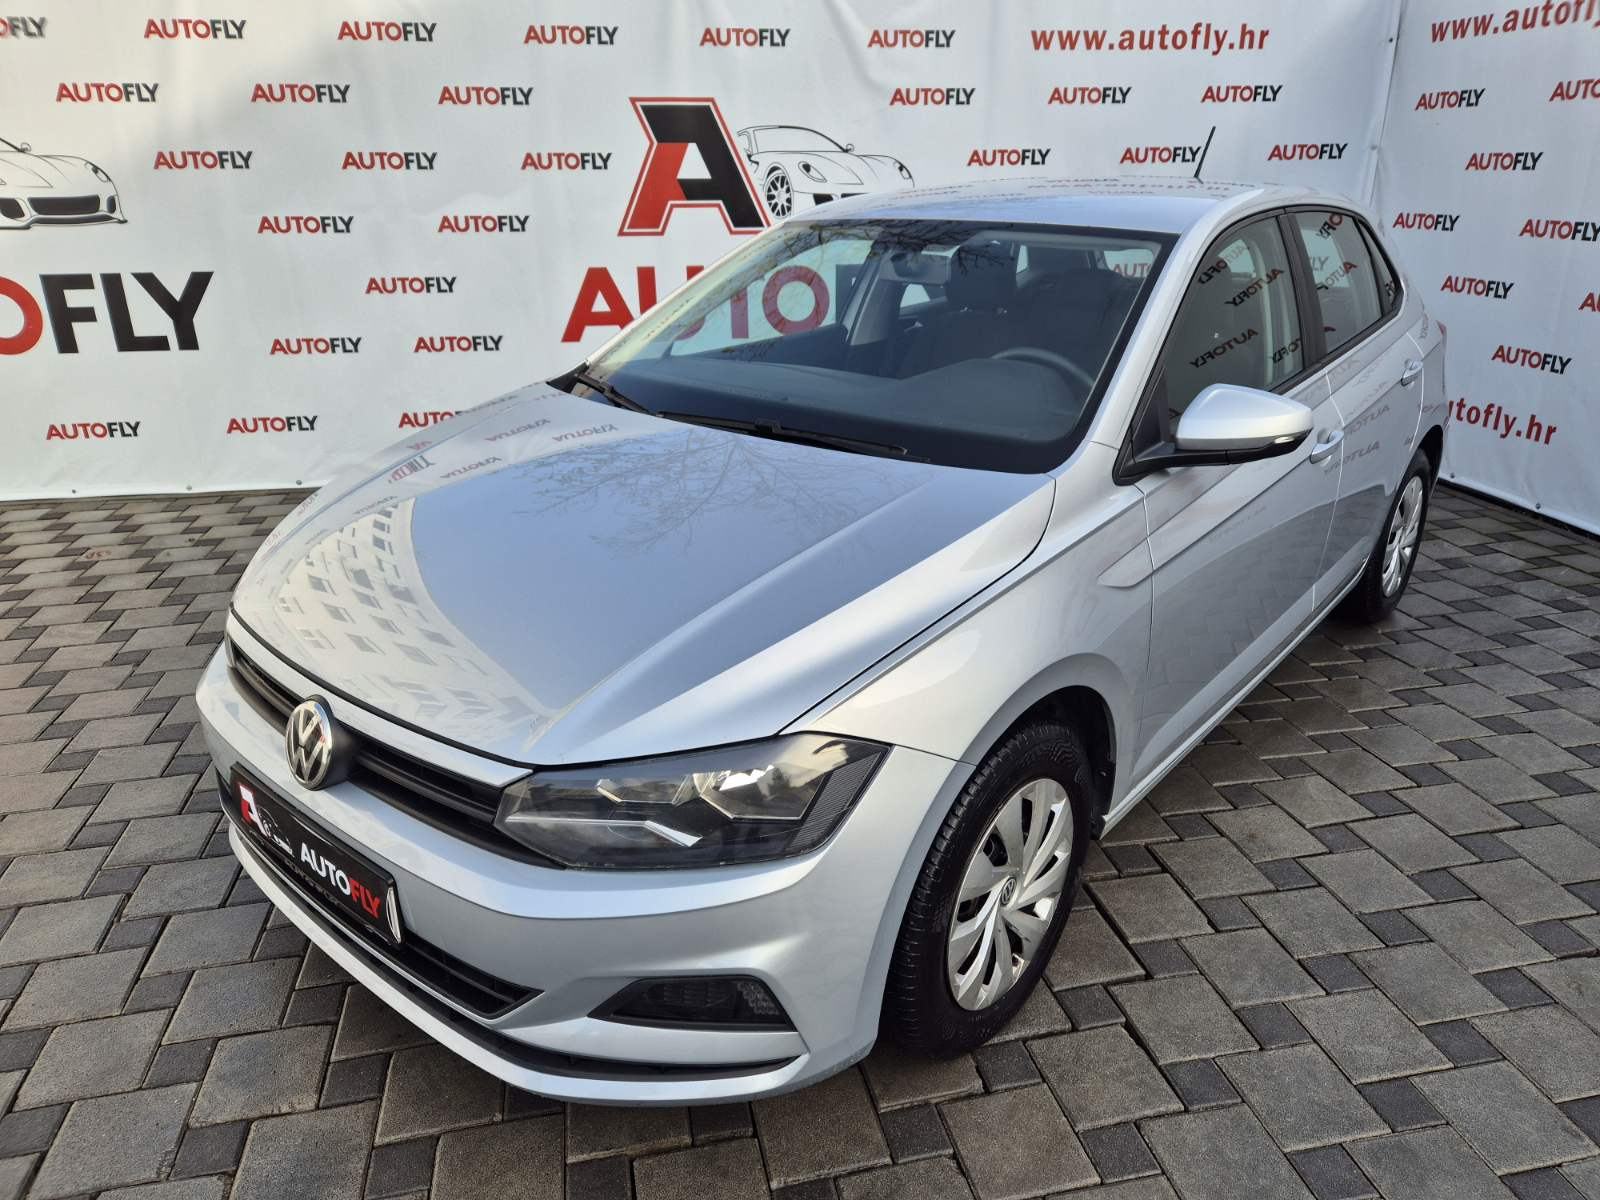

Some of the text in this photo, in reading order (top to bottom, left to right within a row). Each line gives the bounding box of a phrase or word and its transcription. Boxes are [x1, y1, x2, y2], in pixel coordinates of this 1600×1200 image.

[144, 19, 247, 39] AUTOFLY
[1431, 0, 1600, 43] www.autofl
[338, 22, 436, 42] AUTOFLY
[524, 25, 619, 45] AUTOFLY
[700, 28, 791, 47] AUTOFLY
[868, 30, 956, 48] AUTOFLY
[1031, 23, 1270, 55] www.autofly.hr
[56, 83, 159, 102] AUTOFLY
[251, 84, 350, 103] AUTOFLY
[439, 87, 534, 105] AUTOFLY
[890, 88, 976, 105] AUTOFLY
[1048, 87, 1132, 104] AUTOFLY
[1202, 85, 1283, 102] AUTOFLY
[1416, 88, 1486, 110] AUTOFLY
[154, 151, 253, 169] AUTOFLY
[968, 149, 1051, 166] AUTOFLY
[1120, 147, 1201, 163] AUTOFLY
[1268, 143, 1349, 160] AUTOFLY
[342, 152, 438, 170] AUTOFLY
[522, 153, 612, 170] AUTOFLY
[1466, 152, 1544, 170] AUTOFLY
[258, 216, 354, 233] AUTOFLY
[438, 216, 529, 233] AUTOFLY
[1393, 213, 1460, 231] AUTOFLY
[366, 277, 456, 294] AUTOFLY
[1441, 276, 1514, 299] AUTOFLY
[270, 337, 362, 355] AUTOFLY
[414, 336, 503, 352] AUTOFLY
[1492, 346, 1572, 374] AUTOFLY
[47, 421, 141, 440] AUTOFLY
[227, 416, 318, 434] AUTOFLY
[301, 842, 381, 919] AUTOFLY
